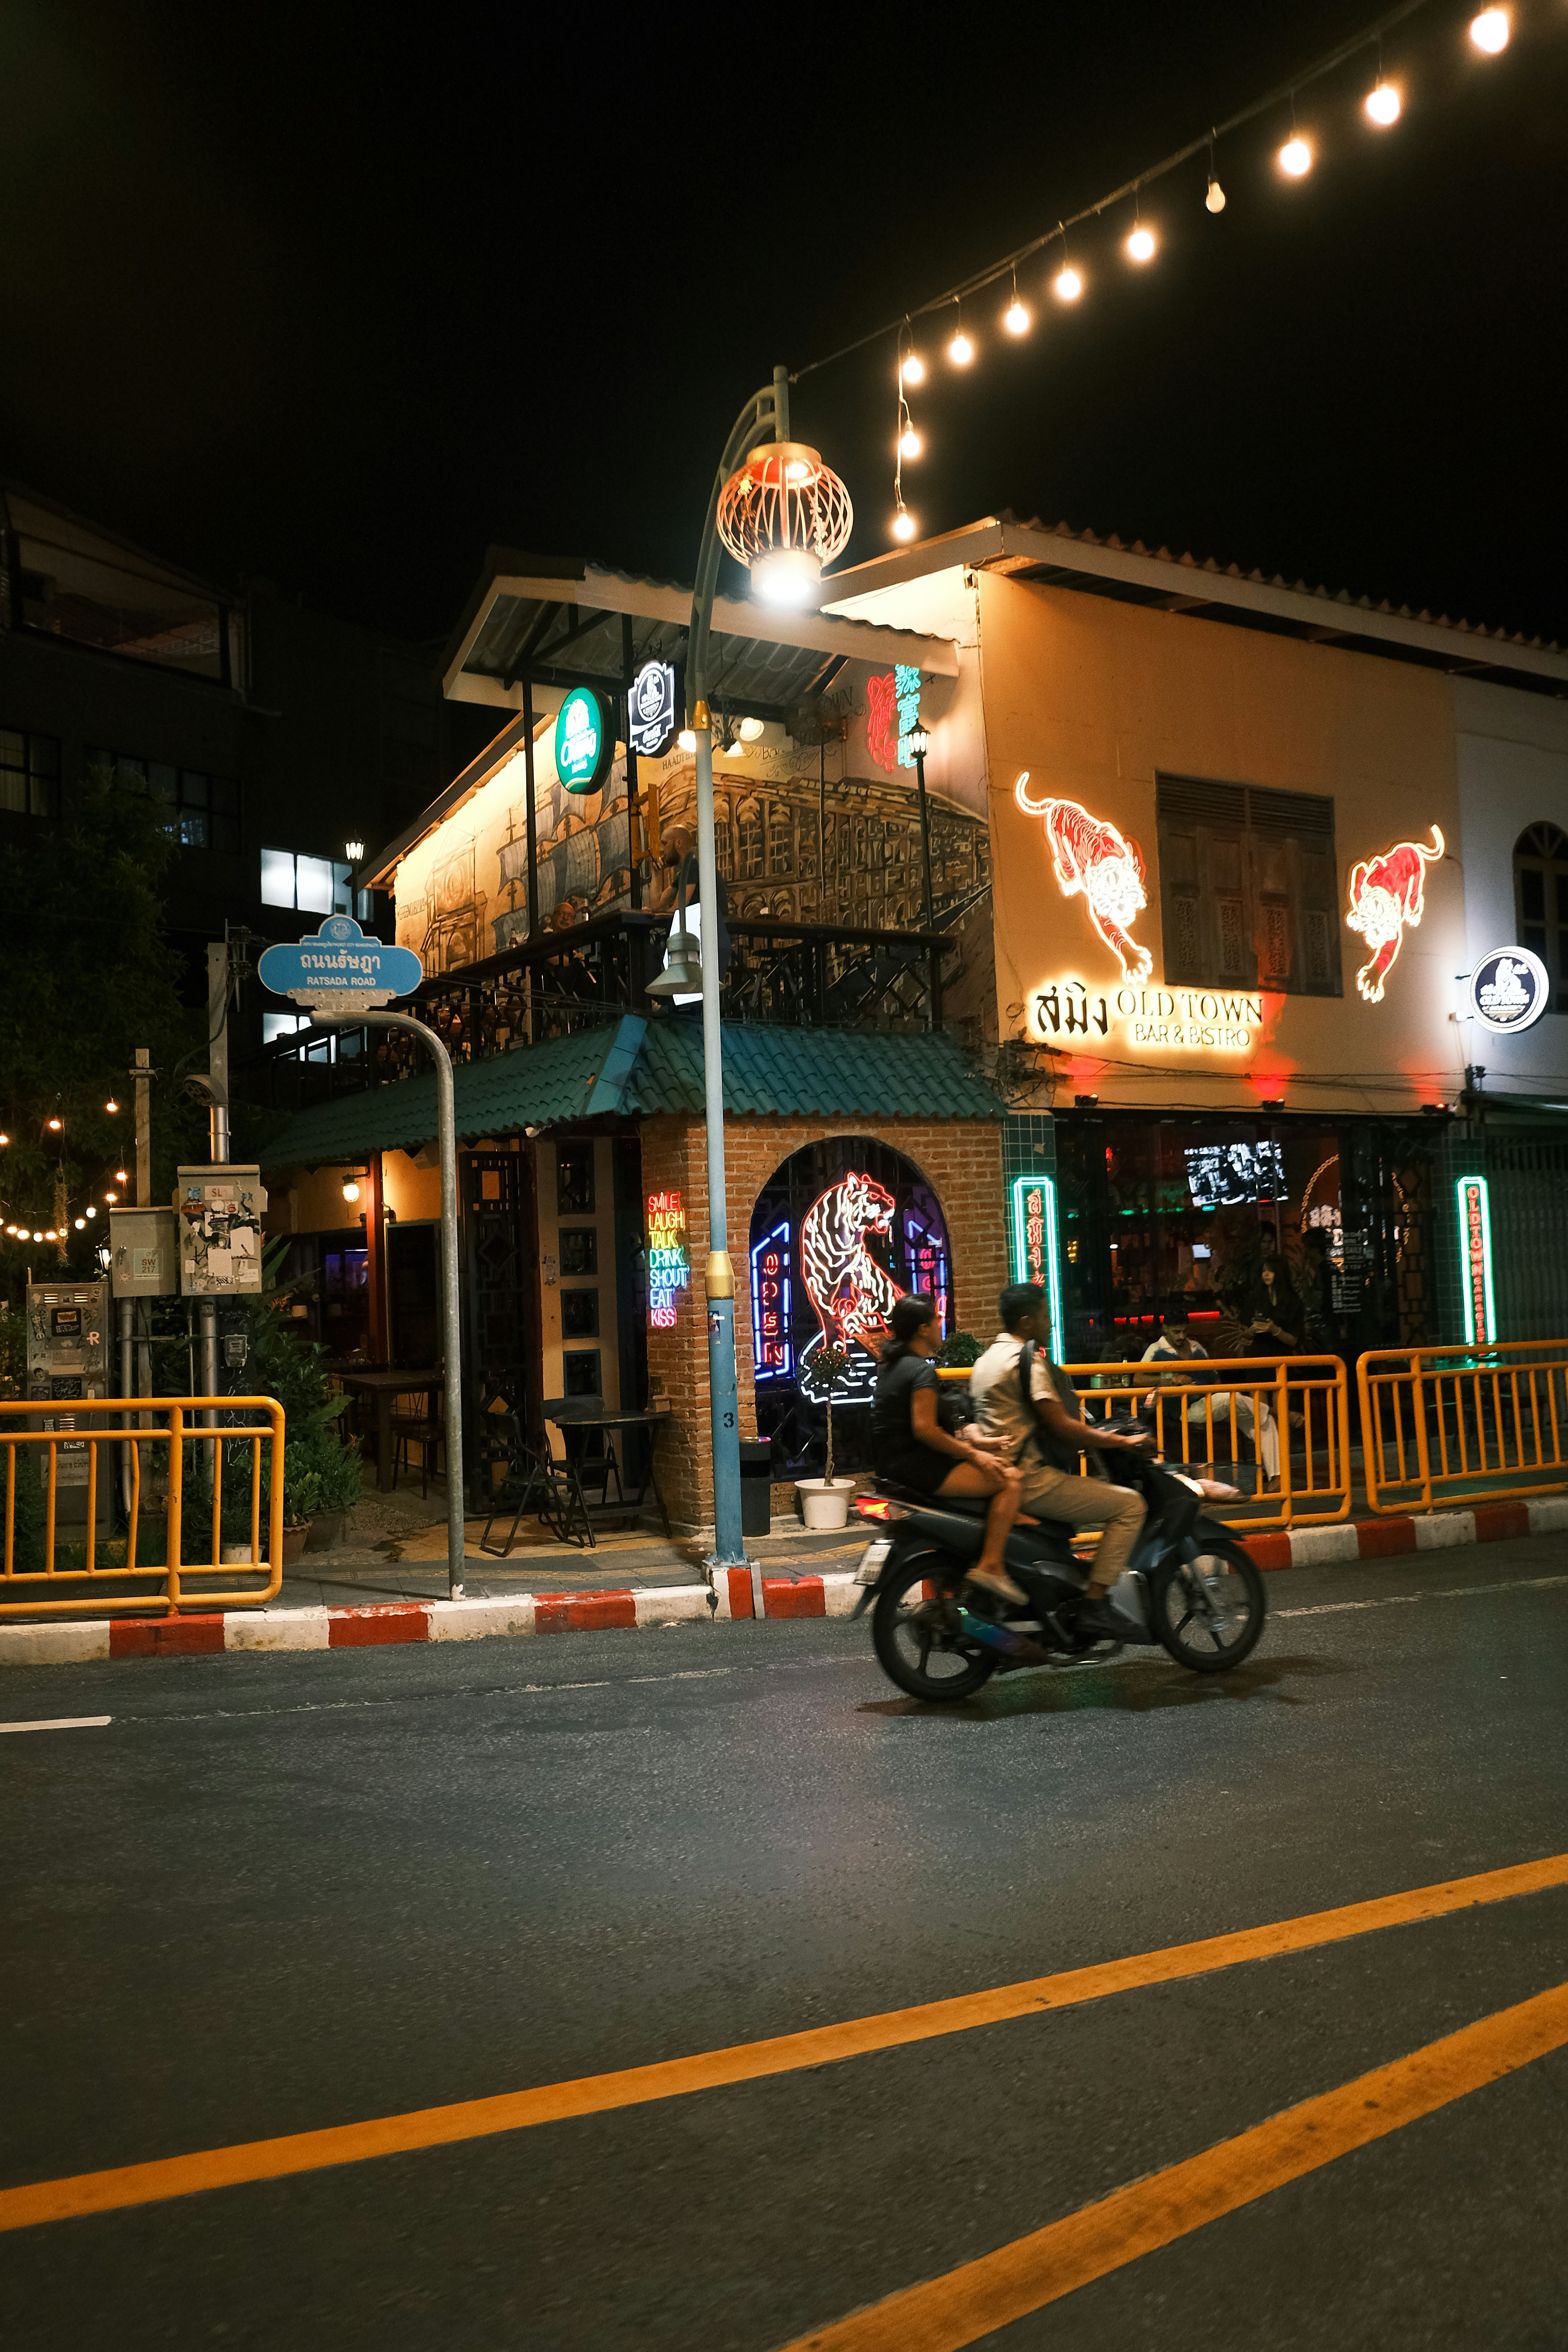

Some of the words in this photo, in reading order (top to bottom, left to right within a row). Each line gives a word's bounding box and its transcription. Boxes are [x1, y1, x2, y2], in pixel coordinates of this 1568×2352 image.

[300, 949, 380, 974] ถนนรัษฎา
[307, 976, 348, 986] RATSADA
[351, 977, 377, 986] ROAD
[1036, 982, 1108, 1035] สมิง
[1117, 989, 1174, 1017] OLD
[1181, 994, 1264, 1023] TOWN
[1136, 1023, 1168, 1043] BAR
[1174, 1025, 1184, 1044] &
[1190, 1026, 1250, 1046] BISTRO
[211, 1188, 223, 1197] SL
[649, 1193, 678, 1212] SMILE
[651, 1308, 675, 1327] KISS
[724, 1412, 734, 1428] 3
